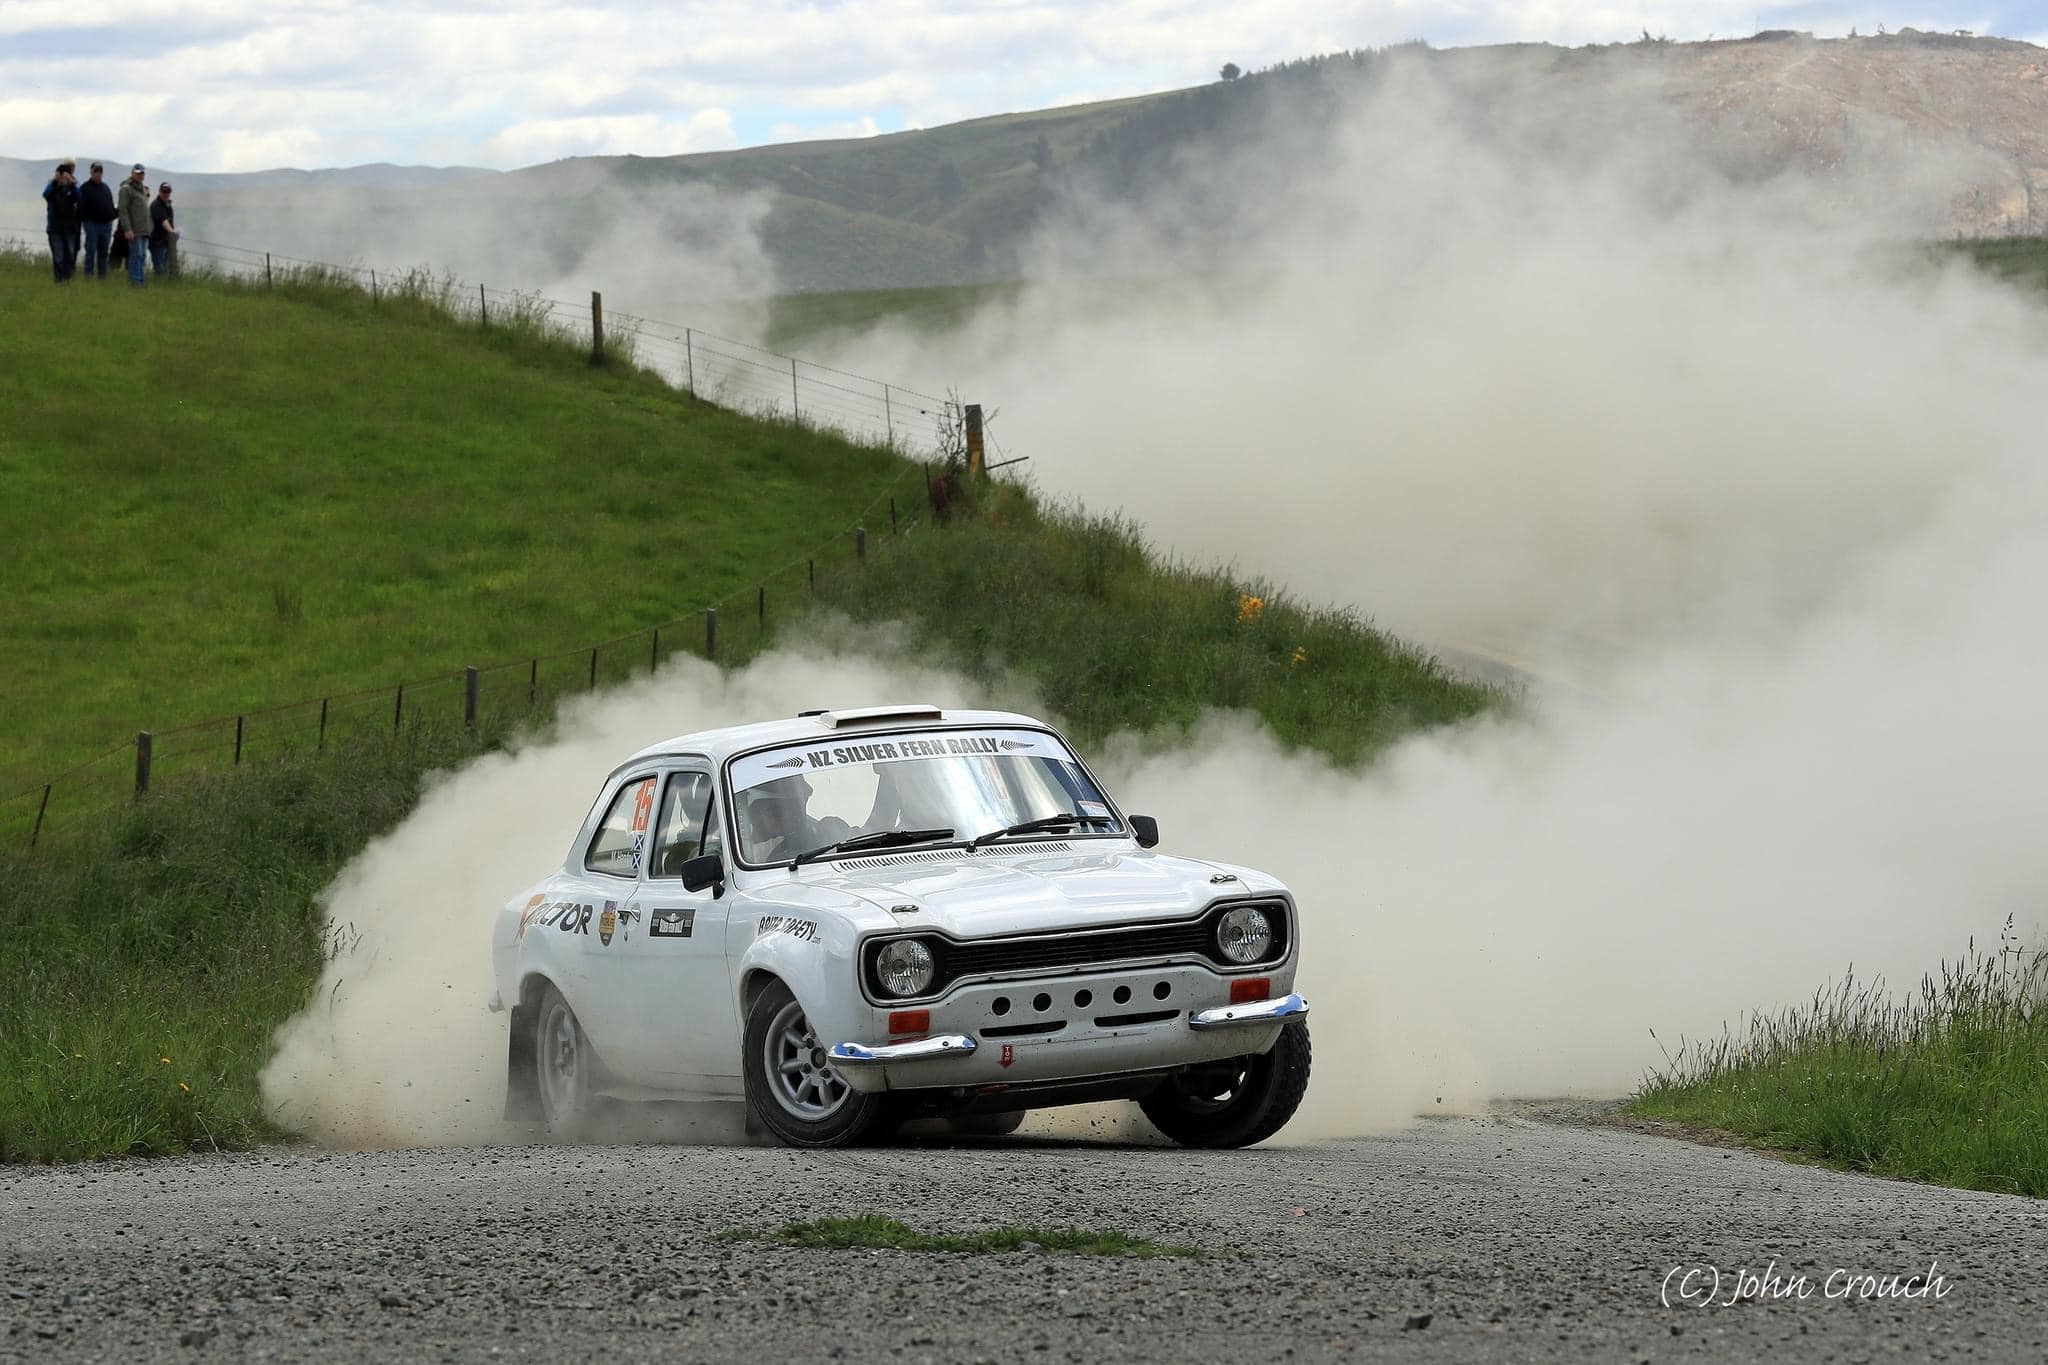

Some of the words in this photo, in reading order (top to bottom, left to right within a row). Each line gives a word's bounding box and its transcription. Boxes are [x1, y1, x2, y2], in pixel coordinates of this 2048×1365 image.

[807, 750, 833, 768] NZ
[837, 743, 898, 764] SILVER
[898, 739, 947, 757] FERN
[946, 737, 1000, 755] RALLY
[631, 778, 657, 831] 15
